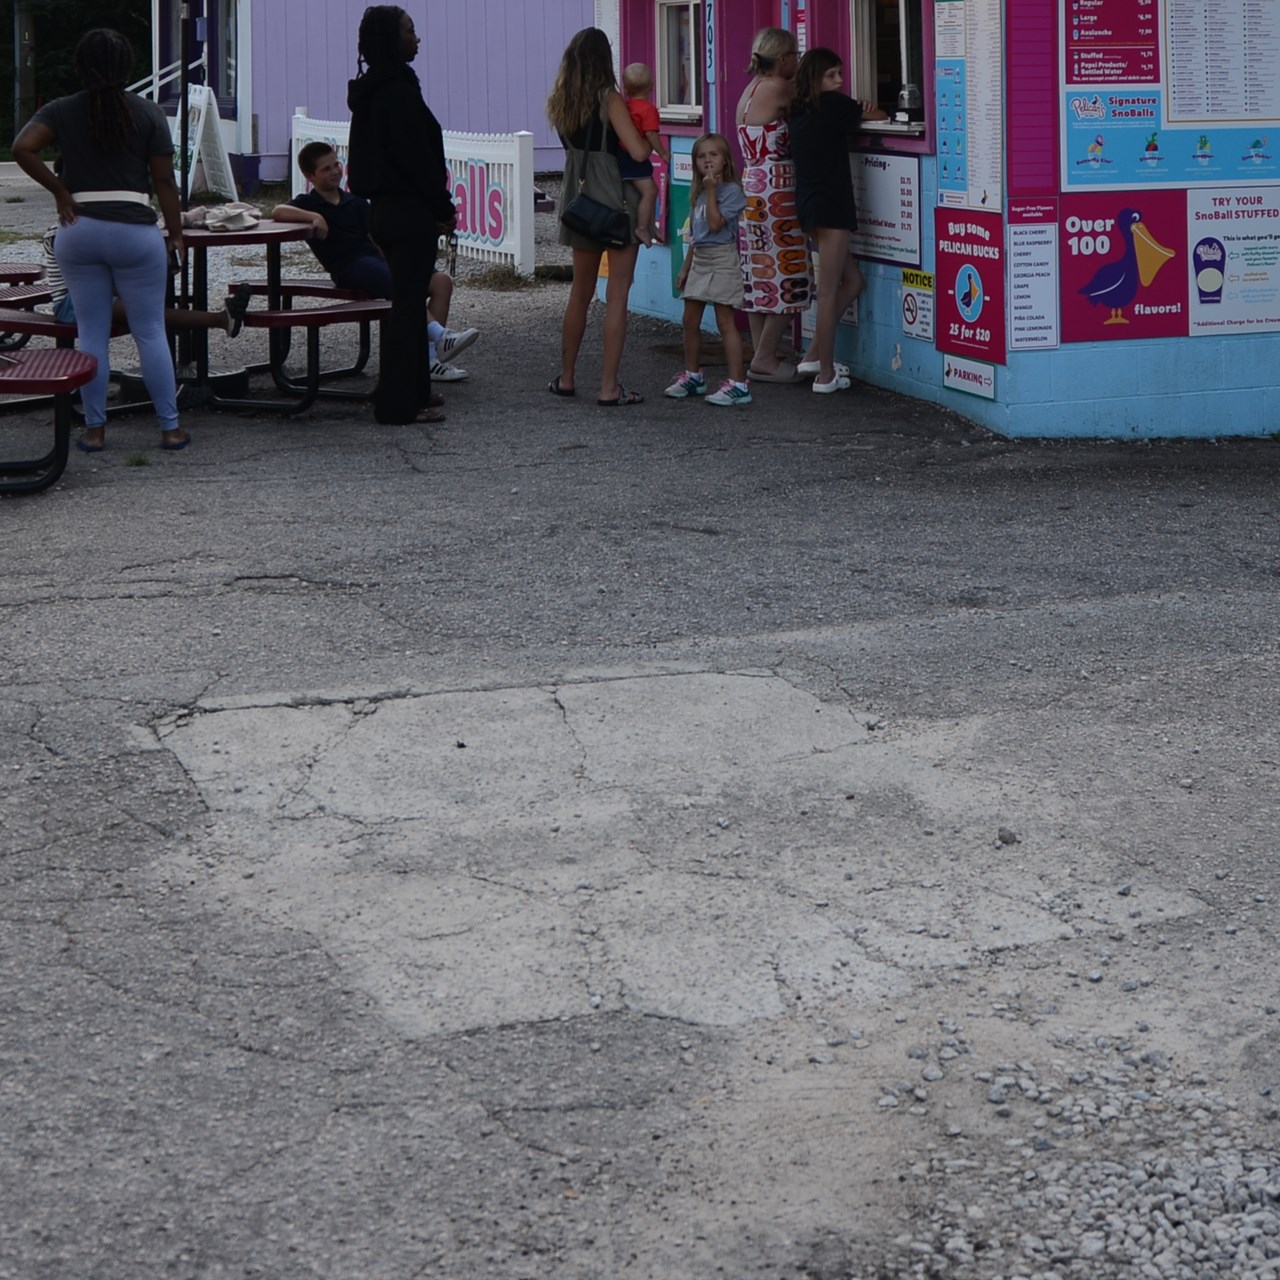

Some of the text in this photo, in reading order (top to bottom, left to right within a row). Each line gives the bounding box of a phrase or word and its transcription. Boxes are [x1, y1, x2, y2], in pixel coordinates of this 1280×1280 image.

[706, 3, 714, 69] 703
[1080, 61, 1098, 69] Pepsi
[1071, 97, 1105, 118] Pelican's
[1108, 96, 1157, 107] Signature
[1111, 109, 1154, 118] SnoBalls
[864, 157, 887, 170] Pricing
[1211, 195, 1263, 207] TRY YOUR
[1195, 208, 1280, 221] SnoBall STUFFED
[948, 221, 991, 241] Buy some
[1065, 216, 1115, 234] Over
[1067, 234, 1111, 256] 100
[1257, 234, 1273, 242] you'll
[939, 240, 1000, 260] PELICAN BUCKS
[903, 271, 932, 288] NOTICE
[1134, 302, 1182, 315] flavors!
[949, 322, 991, 342] 25 for $20
[953, 368, 983, 386] PARKING
